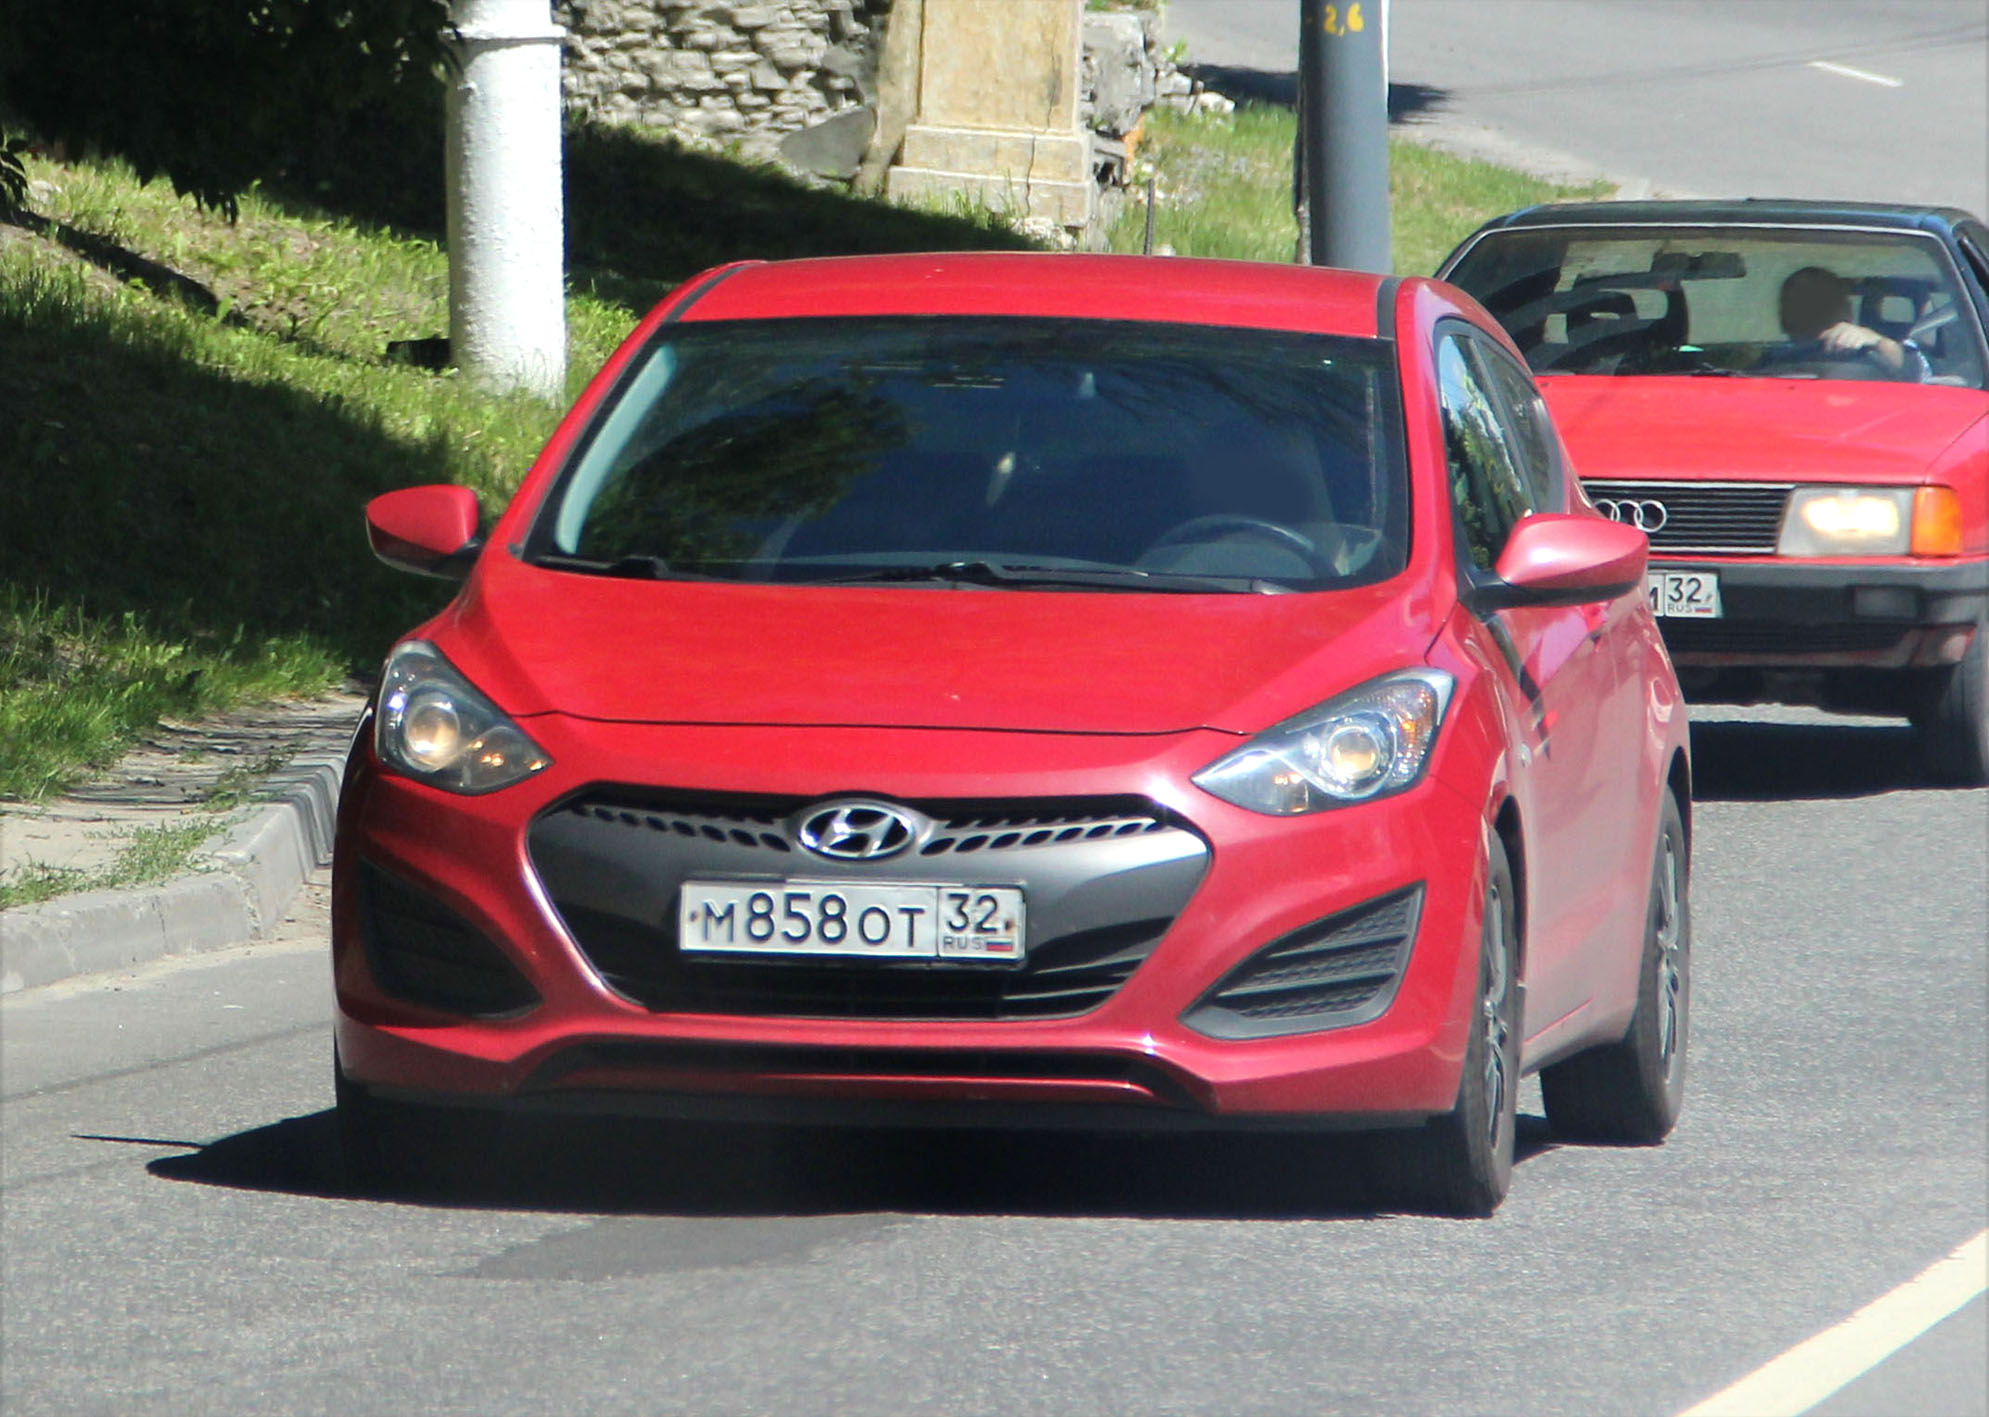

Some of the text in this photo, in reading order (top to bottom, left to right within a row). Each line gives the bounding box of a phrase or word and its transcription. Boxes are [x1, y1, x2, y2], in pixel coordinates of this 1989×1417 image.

[1668, 577, 1702, 603] 32
[1667, 603, 1693, 614] RUS
[948, 893, 998, 933] 32
[943, 936, 985, 951] RUS
